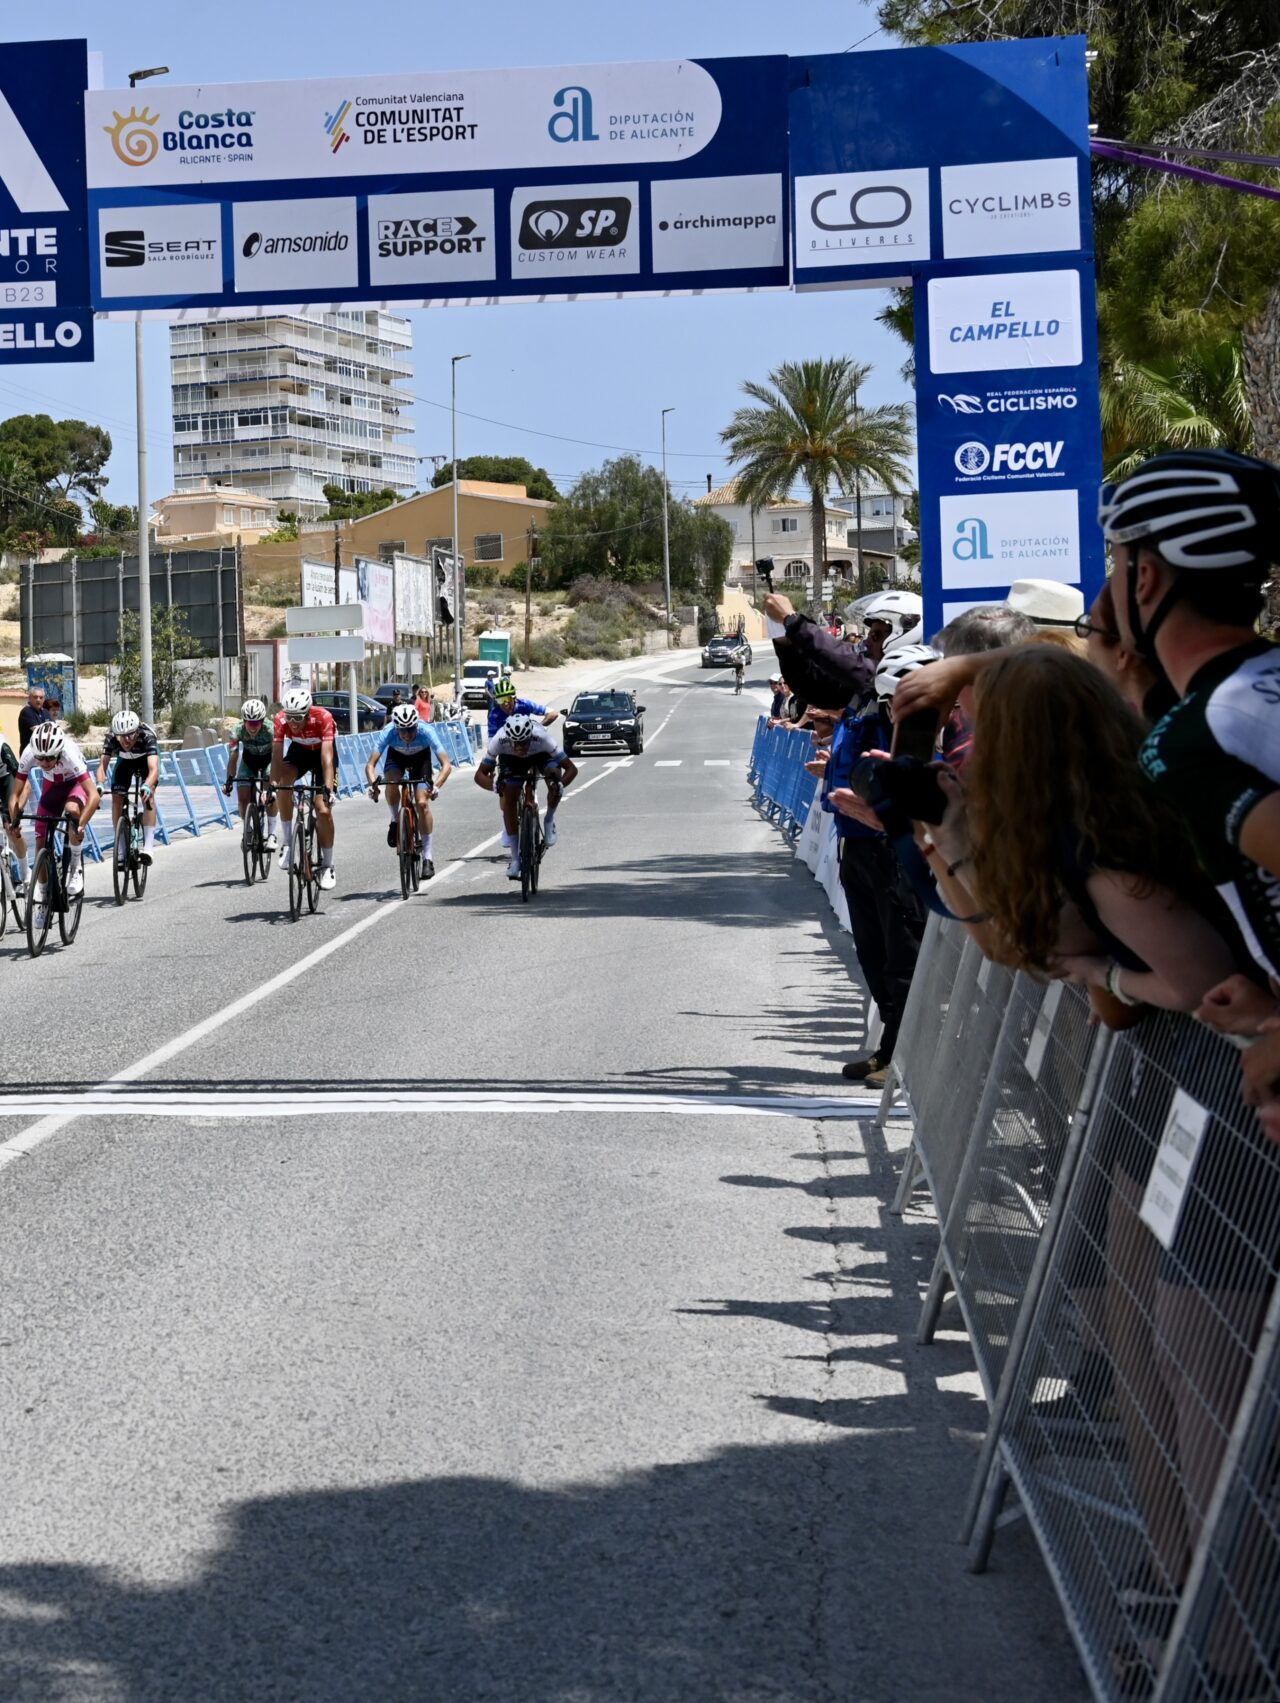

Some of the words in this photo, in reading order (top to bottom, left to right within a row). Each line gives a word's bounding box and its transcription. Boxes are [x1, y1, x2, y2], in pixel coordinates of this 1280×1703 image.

[355, 95, 407, 106] Comunitat
[410, 92, 464, 104] Valenciana
[178, 109, 253, 130] Costa
[355, 107, 464, 127] COMUNITAT
[610, 109, 694, 126] DIPUTACIÓN
[163, 131, 253, 151] Blanca
[364, 128, 387, 145] DE
[393, 124, 478, 143] L'ESPORT
[610, 129, 625, 140] DE
[631, 126, 694, 139] ALICANTE
[180, 154, 222, 165] ALICANTE
[228, 153, 253, 162] SPAIN
[949, 192, 1072, 215] CYCLIMBS
[378, 217, 452, 240] RACE
[673, 214, 776, 230] archimappa
[148, 239, 217, 253] SEAT
[264, 230, 349, 253] amsonido
[378, 237, 486, 258] SUPPORT
[811, 234, 913, 249] OLIVERES
[170, 253, 215, 261] RODRÍGUEZ
[518, 251, 577, 262] CUSTOM
[586, 248, 627, 260] WEAR
[991, 301, 1015, 318] EL
[949, 319, 1060, 343] CAMPELLO
[1004, 388, 1043, 396] FEDERACIÓN
[1045, 387, 1077, 395] ESPAÑOLA
[987, 395, 1078, 413] CICLISMO
[992, 441, 1065, 472] FCCV
[1036, 470, 1065, 478] Valenciana
[1001, 536, 1069, 548] DIPUTACIÓN
[1001, 550, 1014, 559] DE
[1018, 548, 1070, 559] ALICANTE
